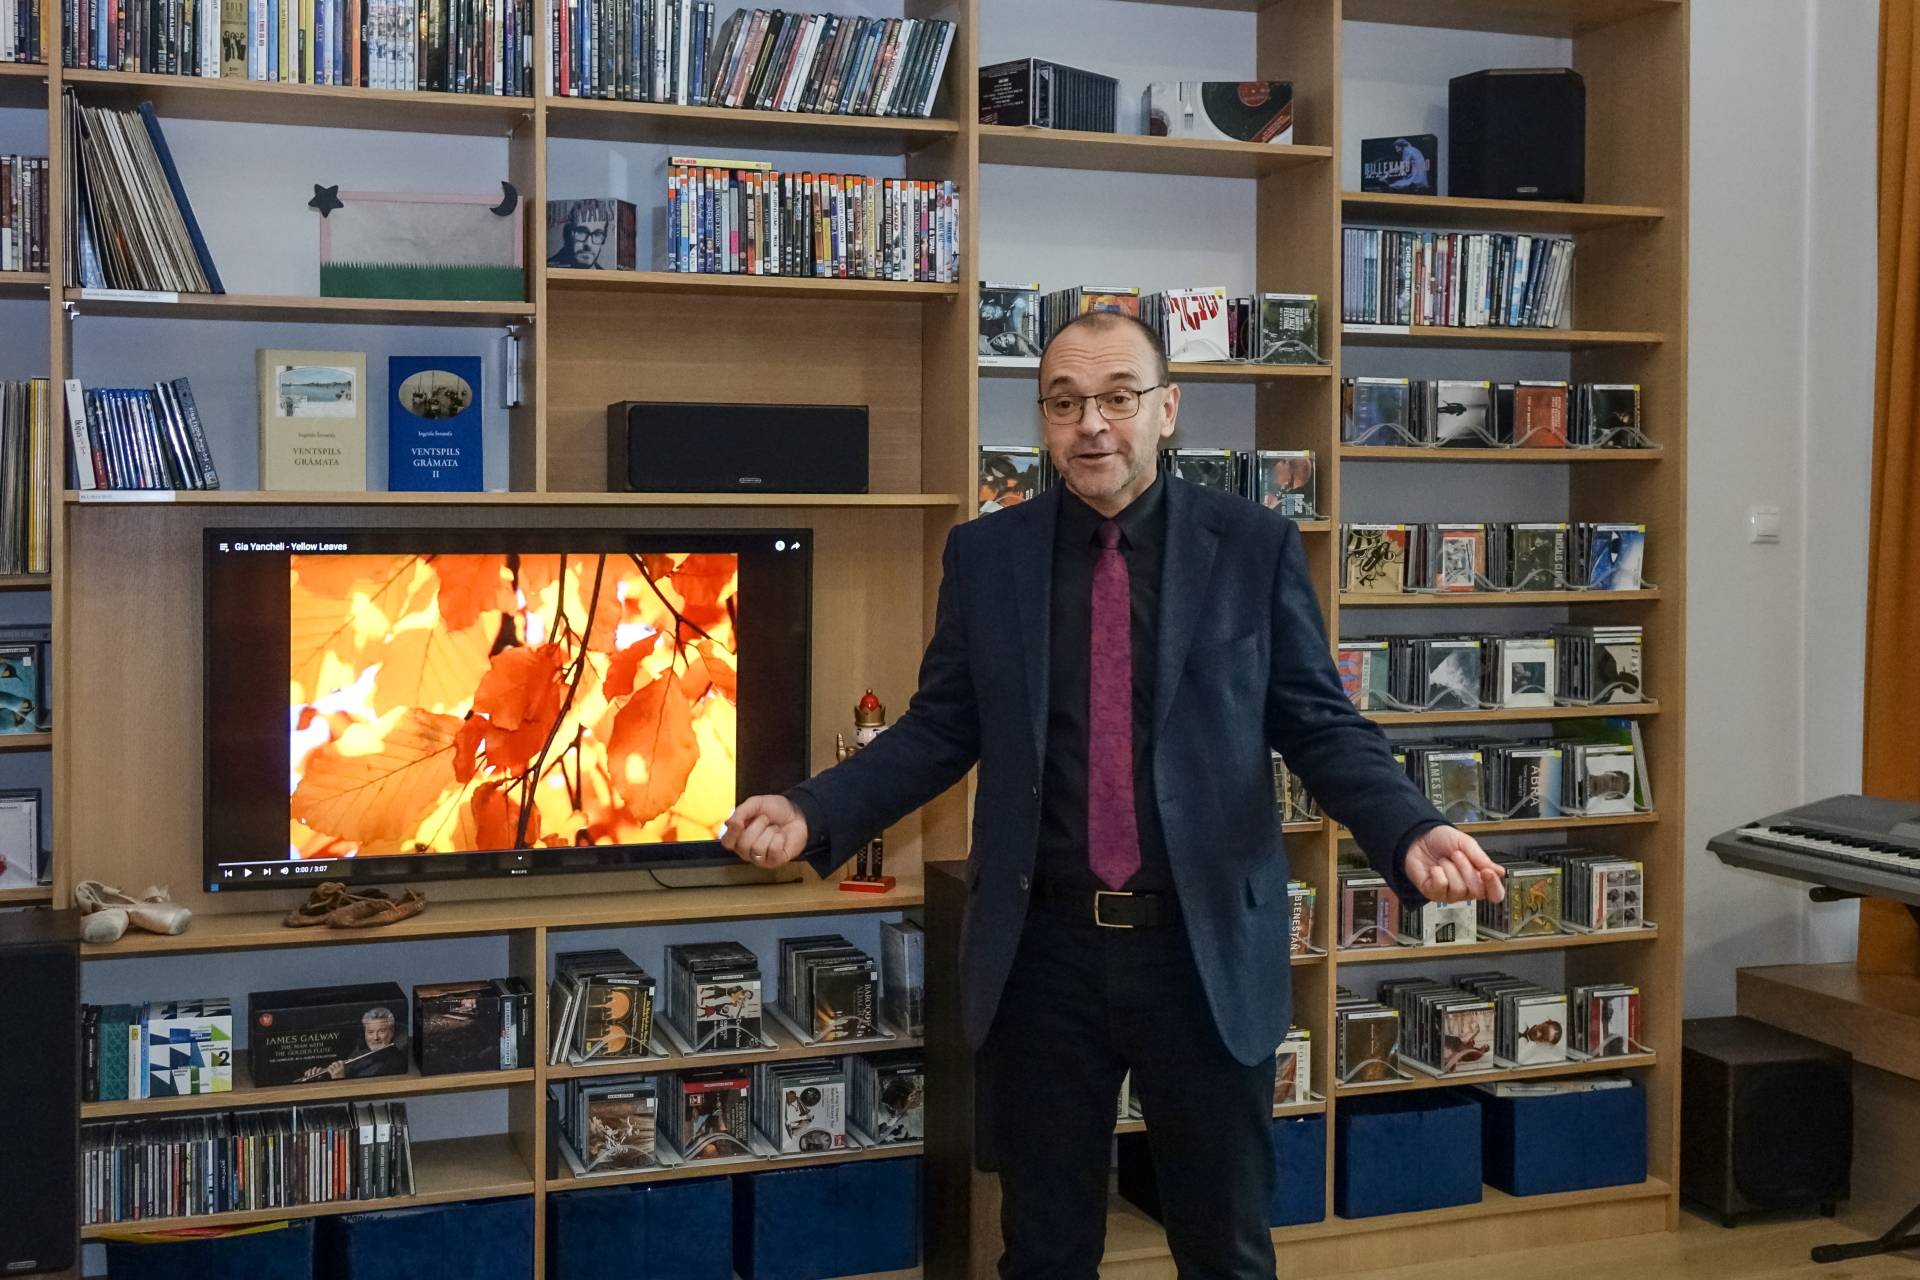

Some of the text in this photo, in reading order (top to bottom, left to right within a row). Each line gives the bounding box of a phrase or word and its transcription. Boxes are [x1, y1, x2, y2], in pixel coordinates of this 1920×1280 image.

[929, 43, 943, 76] ENGELBERT
[838, 216, 846, 244] GOLDMINE
[292, 447, 342, 456] VENTSPILS
[411, 447, 460, 457] VENTSPILS
[294, 457, 340, 467] GRĀMATA
[413, 457, 459, 467] GRĀMATA
[432, 470, 439, 479] II
[234, 541, 250, 551] Gia
[250, 541, 286, 551] Yancheli
[291, 541, 318, 552] Yellow
[319, 541, 348, 552] Leaves
[1554, 533, 1564, 561] MARSALIS
[1530, 765, 1541, 806] ABRA
[295, 866, 309, 874] 0:00
[314, 865, 328, 873] 3:07
[1289, 895, 1303, 950] BIENESTAN
[266, 1031, 340, 1046] JAMES GALWAY
[285, 1048, 313, 1056] GOLDEN
[313, 1046, 331, 1054] FLUTE
[218, 1050, 231, 1067] 2
[1297, 1044, 1306, 1087] BOLÉRO
